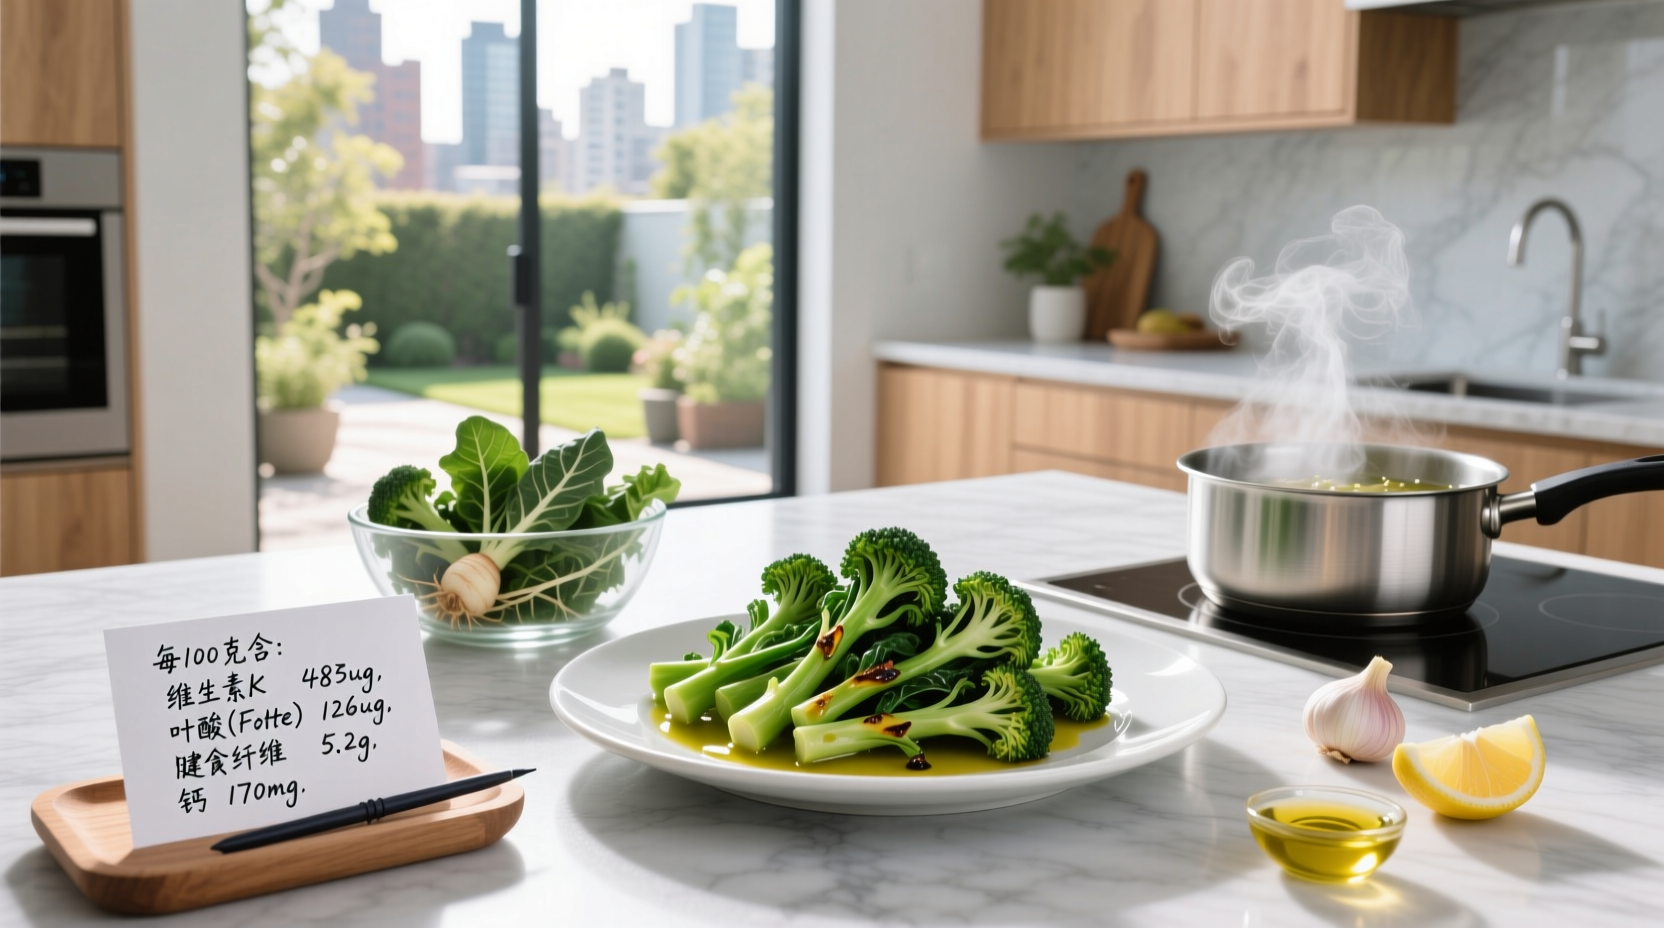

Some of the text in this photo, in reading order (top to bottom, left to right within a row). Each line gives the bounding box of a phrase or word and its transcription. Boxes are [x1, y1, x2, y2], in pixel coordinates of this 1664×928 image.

[166, 671, 267, 711] 维生素K
[177, 787, 207, 814] 钙
